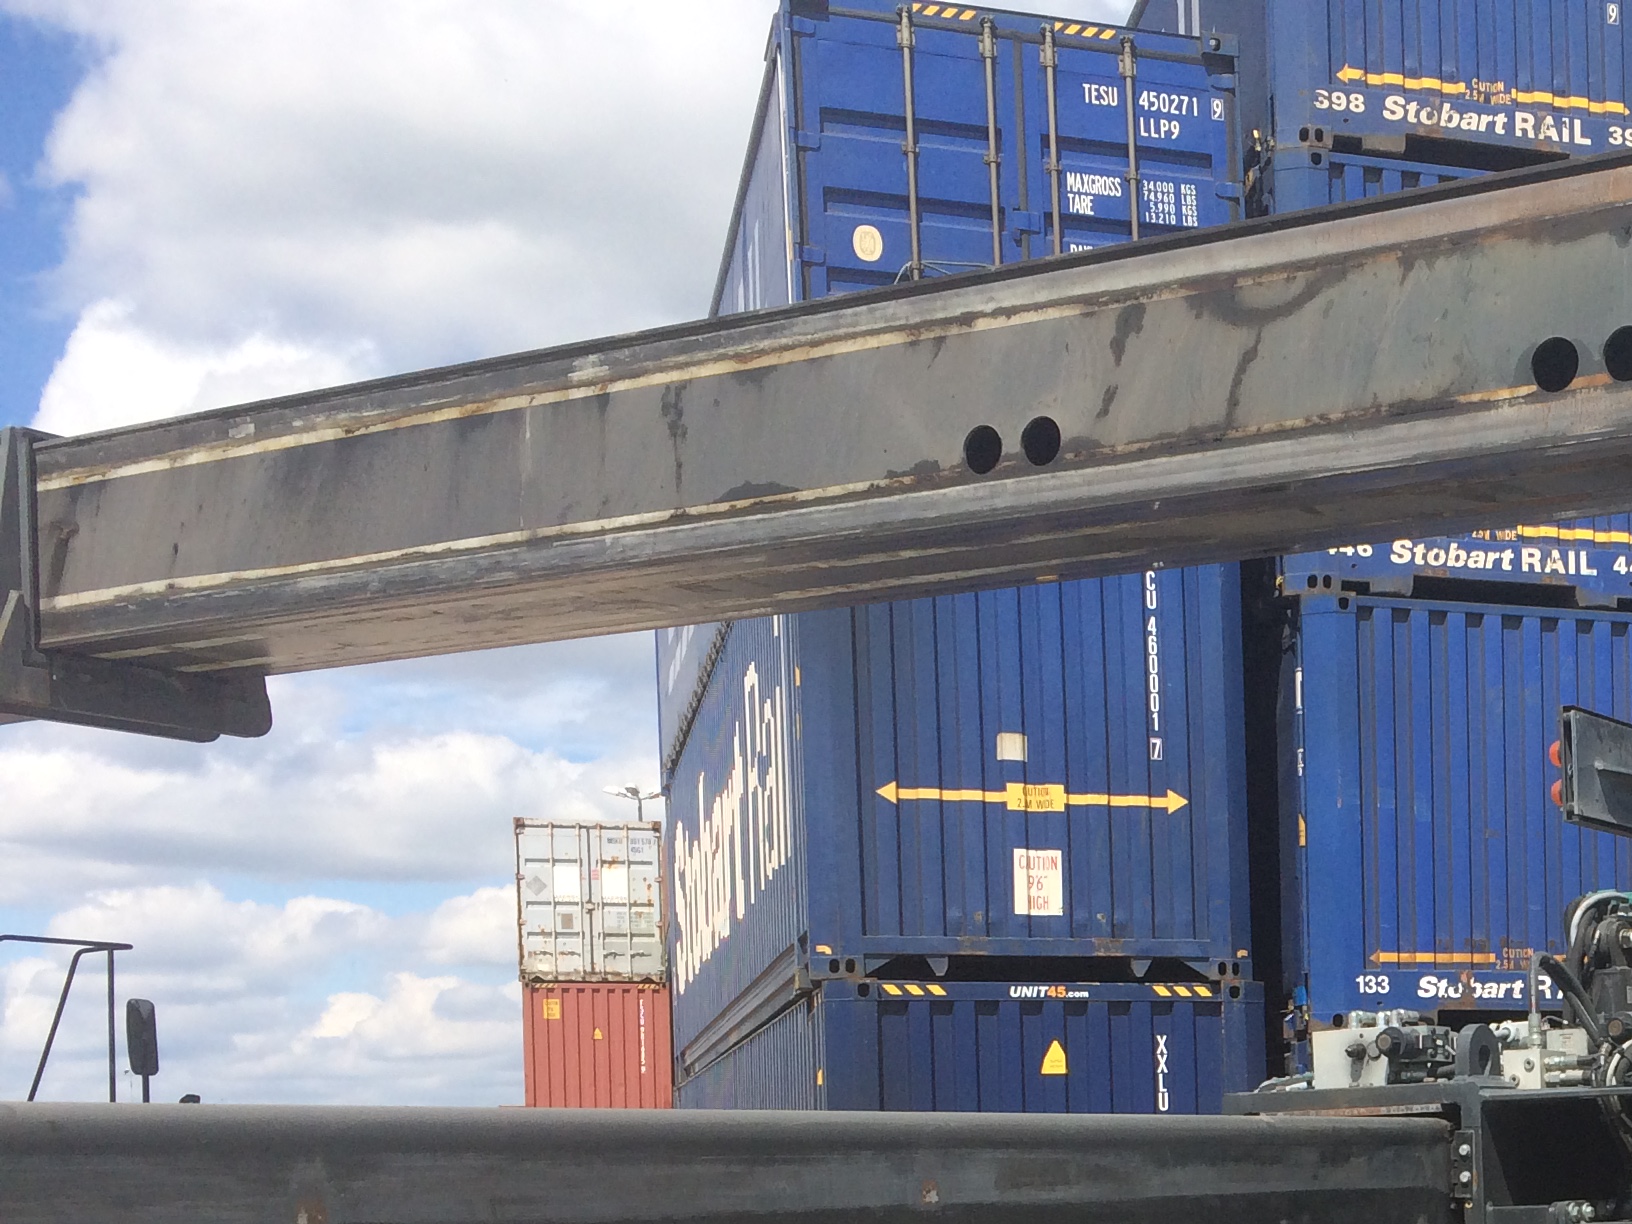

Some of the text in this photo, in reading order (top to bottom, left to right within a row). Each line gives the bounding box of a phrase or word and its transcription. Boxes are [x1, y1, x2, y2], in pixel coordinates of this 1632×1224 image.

[1082, 83, 1223, 120] TESU 450271 9
[1140, 117, 1180, 139] LLP9
[1314, 90, 1365, 113] 398
[1383, 95, 1508, 134] Stobart
[1516, 111, 1591, 145] RAIL
[1066, 172, 1196, 197] MAXGROSS 34.000 KGS
[1068, 194, 1198, 216] TARE 5.990 KGS
[1144, 191, 1196, 205] 74.960 LBS
[1146, 212, 1198, 227] 13.210 LBS
[1390, 540, 1513, 571] Stobart
[1522, 546, 1597, 576] RAIL
[1147, 616, 1159, 731] 460001
[674, 721, 745, 996] Stobart
[1010, 986, 1089, 998] UNIT45.com
[1356, 975, 1390, 994] 133
[1156, 1035, 1168, 1111] XXLU
